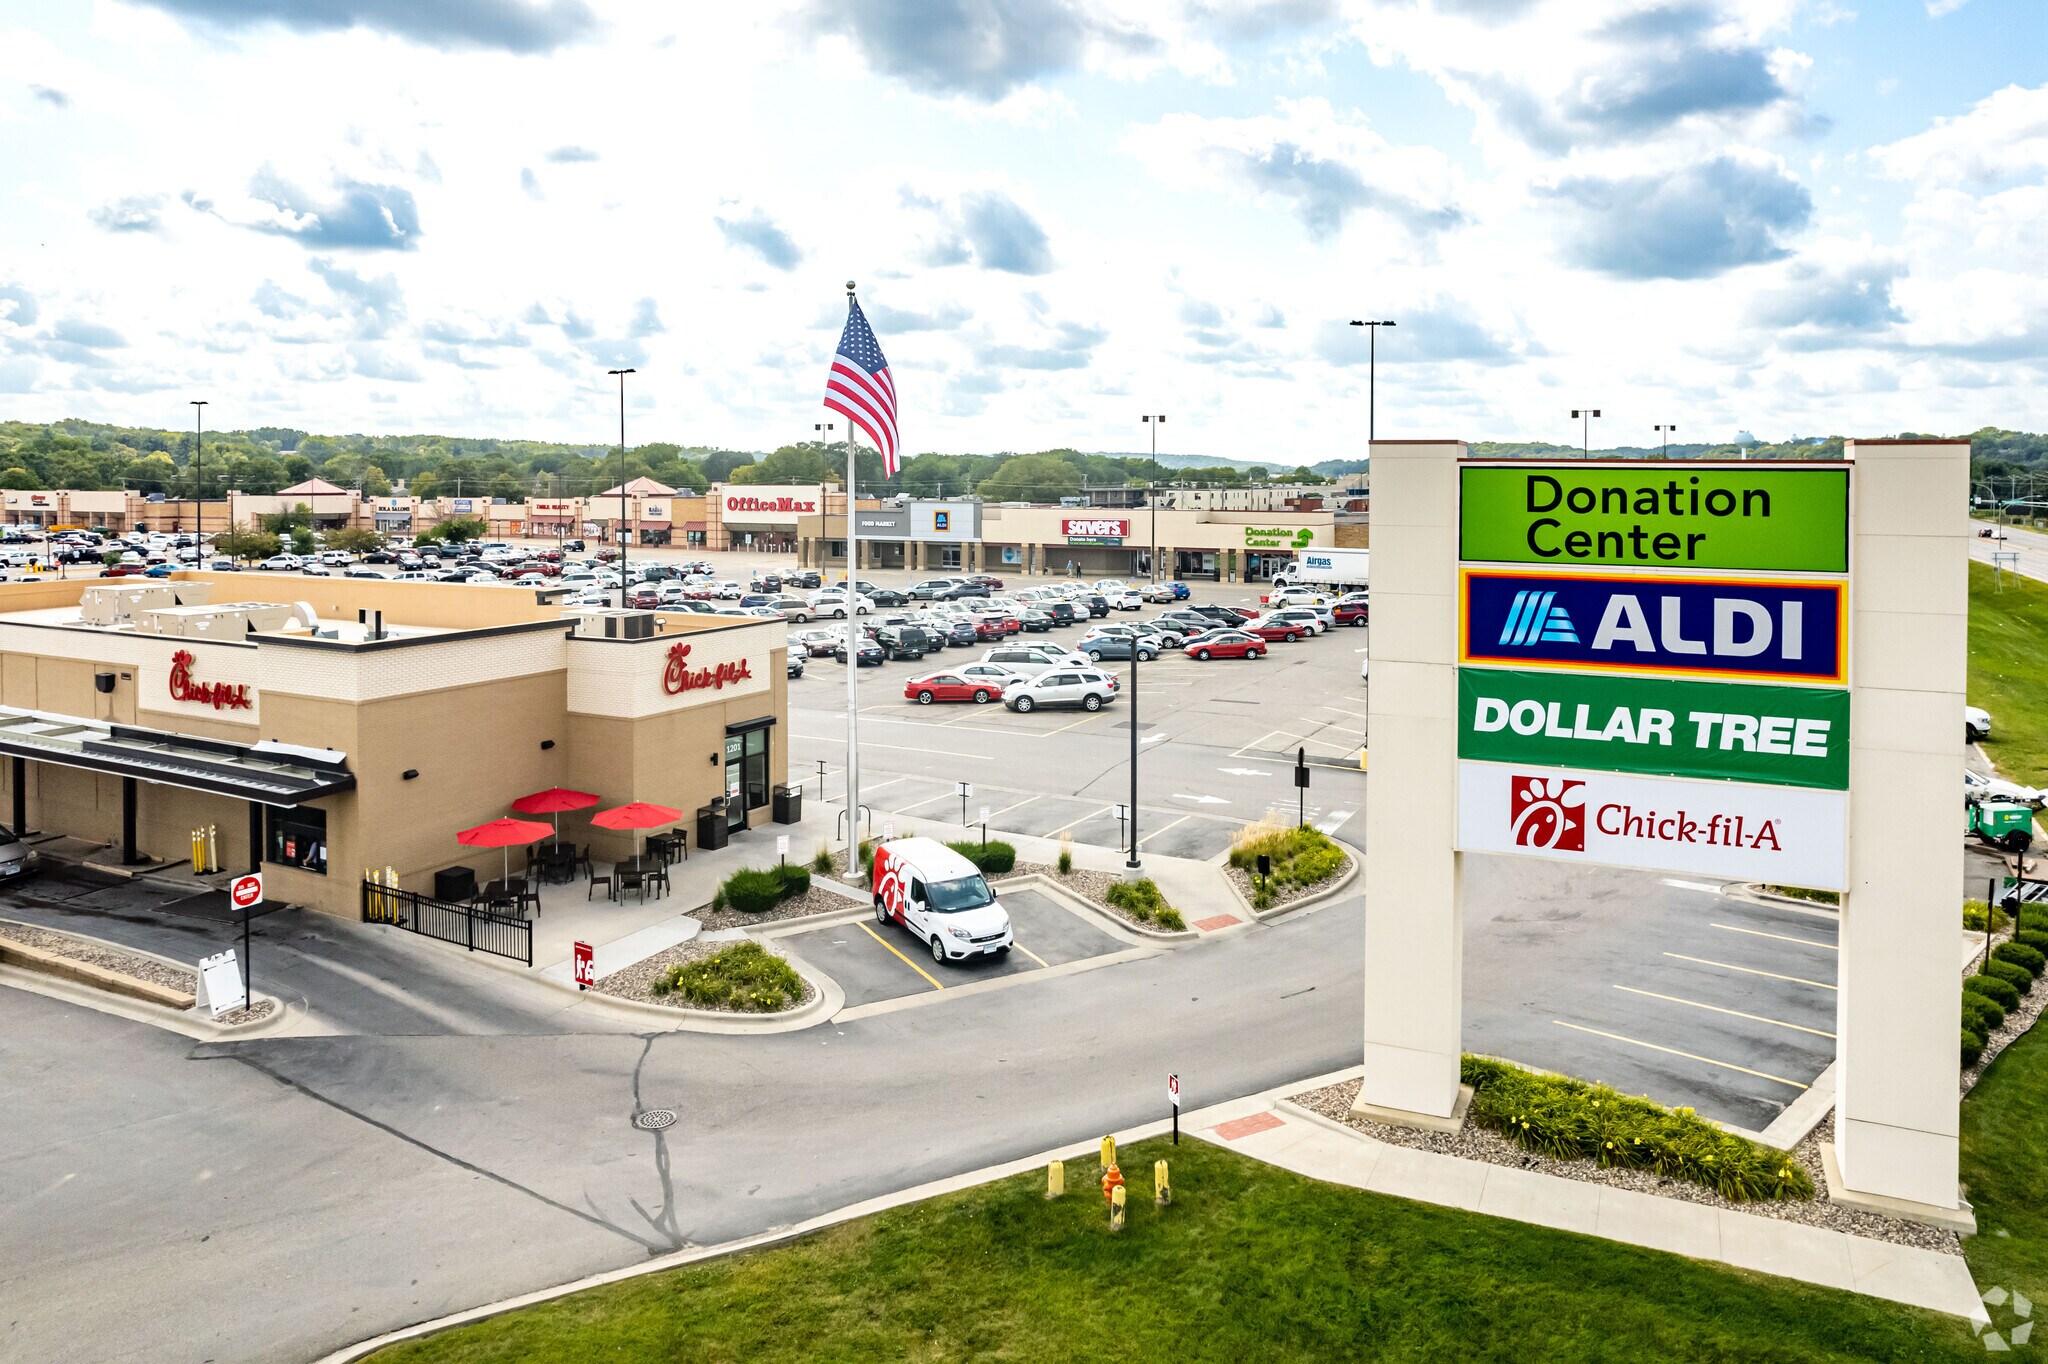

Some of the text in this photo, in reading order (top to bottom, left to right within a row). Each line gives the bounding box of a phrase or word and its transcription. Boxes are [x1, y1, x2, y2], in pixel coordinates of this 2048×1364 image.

[1527, 475, 1770, 517] Donation
[727, 497, 815, 512] OfficeMax
[1245, 527, 1293, 537] Donation
[1527, 519, 1706, 560] Center
[1245, 538, 1281, 547] Center
[1306, 556, 1331, 566] Airgas
[1591, 594, 1802, 660] ALDI
[1473, 697, 1831, 758] DOLLAR TREE
[726, 743, 741, 753] 1201
